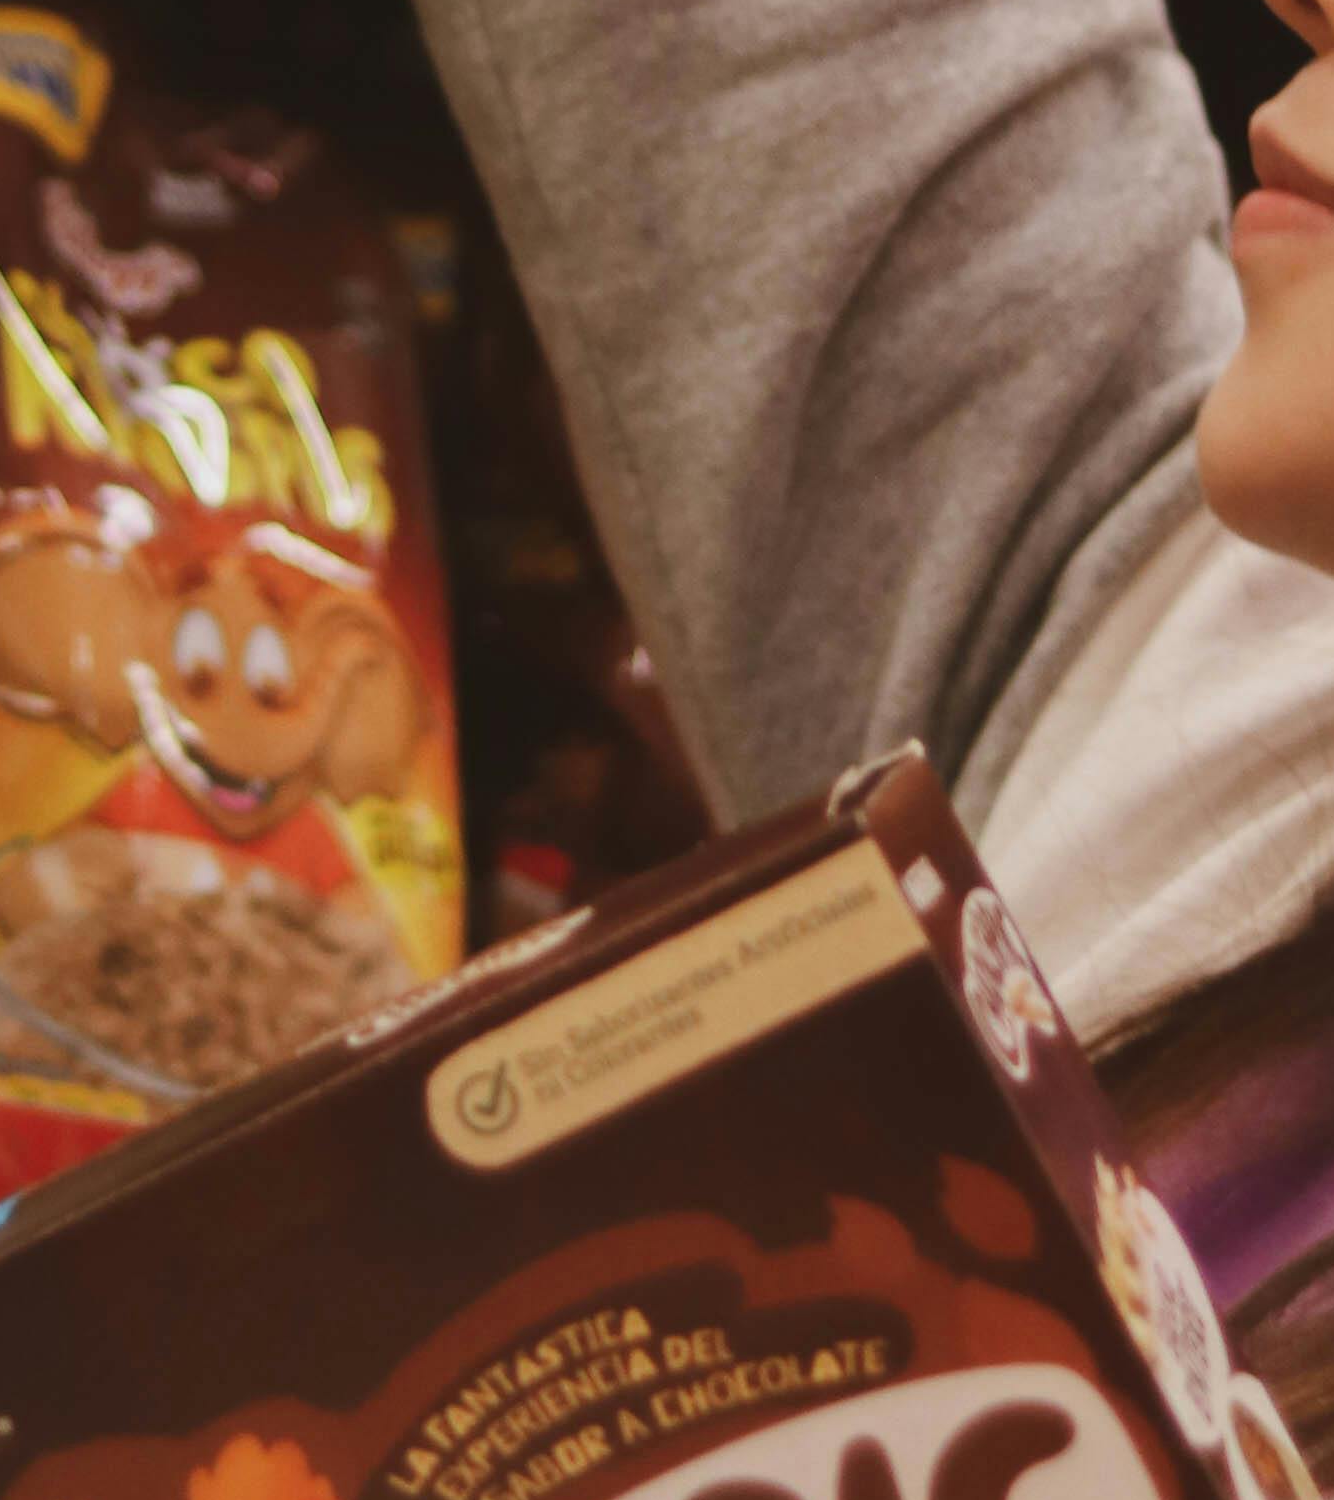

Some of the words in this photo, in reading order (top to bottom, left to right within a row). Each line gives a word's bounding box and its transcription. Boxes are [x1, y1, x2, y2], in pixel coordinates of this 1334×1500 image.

[662, 1327, 733, 1370] DEL
[617, 1408, 651, 1445] A
[650, 1337, 889, 1430] CHOCOLATE
[388, 1445, 440, 1496] LA
